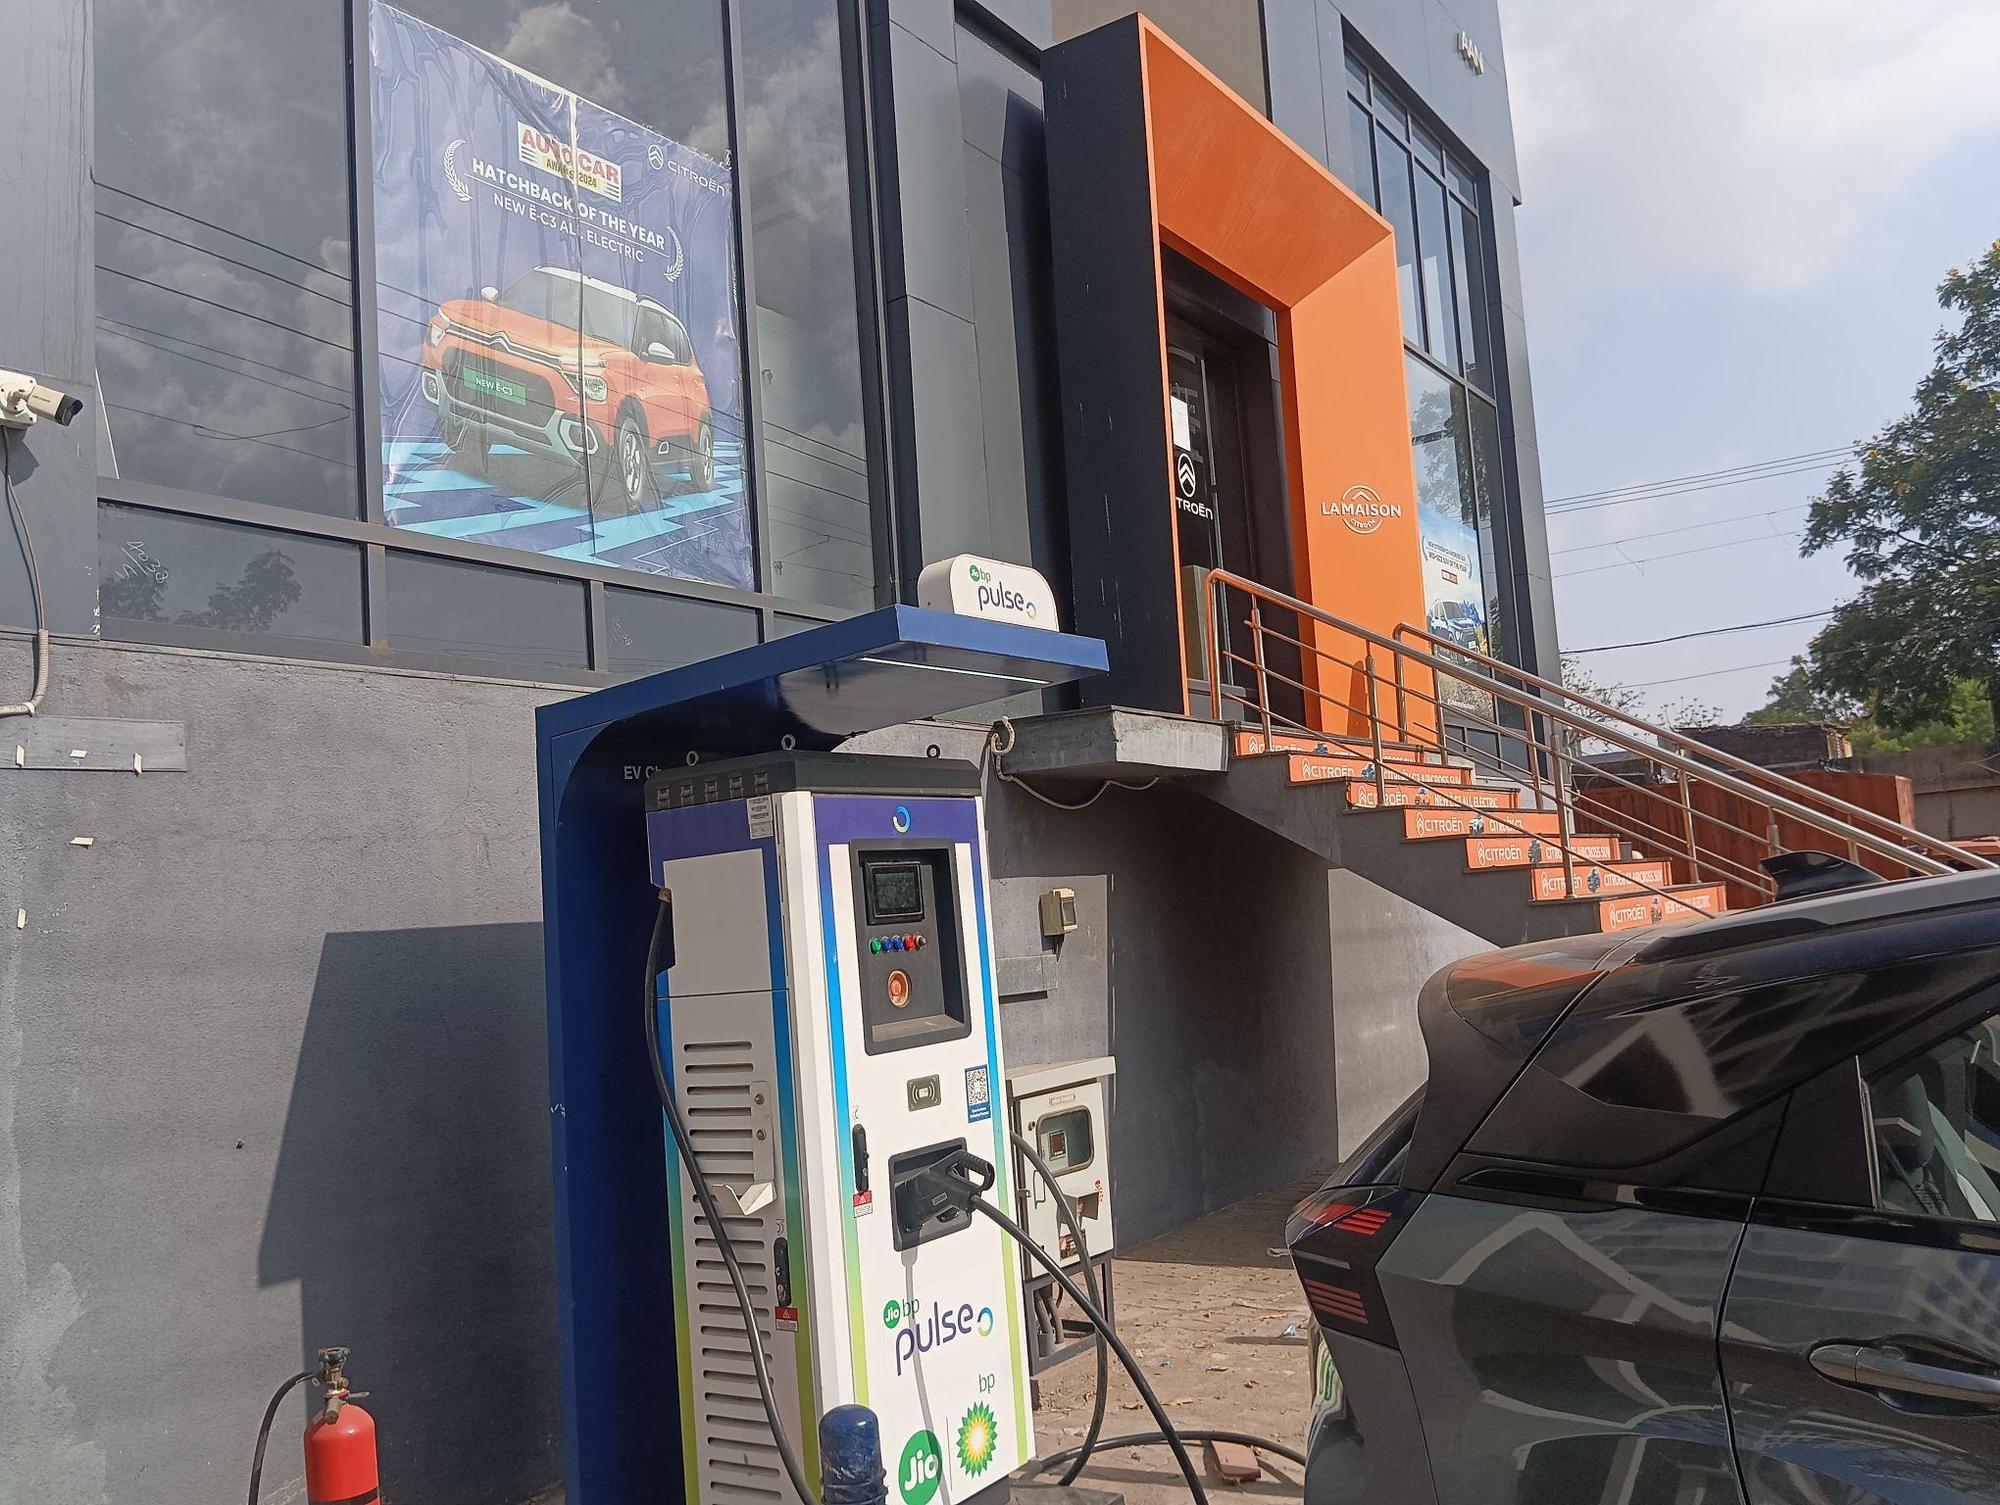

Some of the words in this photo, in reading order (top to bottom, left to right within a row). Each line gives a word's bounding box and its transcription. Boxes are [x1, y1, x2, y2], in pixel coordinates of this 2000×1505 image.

[579, 172, 597, 188] 2024
[472, 158, 574, 213] HATCHBACK
[578, 202, 597, 221] OF
[599, 210, 627, 235] THE
[629, 222, 665, 251] YEAR
[493, 192, 526, 216] NEW
[586, 230, 644, 263] ELECTRIC
[475, 376, 495, 390] NEW
[1176, 496, 1213, 521] TROËN
[977, 580, 1025, 612] pulse
[623, 765, 642, 780] EV
[885, 1306, 900, 1323] Jio
[902, 1298, 920, 1320] bp
[895, 1301, 974, 1376] pulse
[978, 1373, 995, 1394] bp
[904, 1449, 939, 1491] Jio
